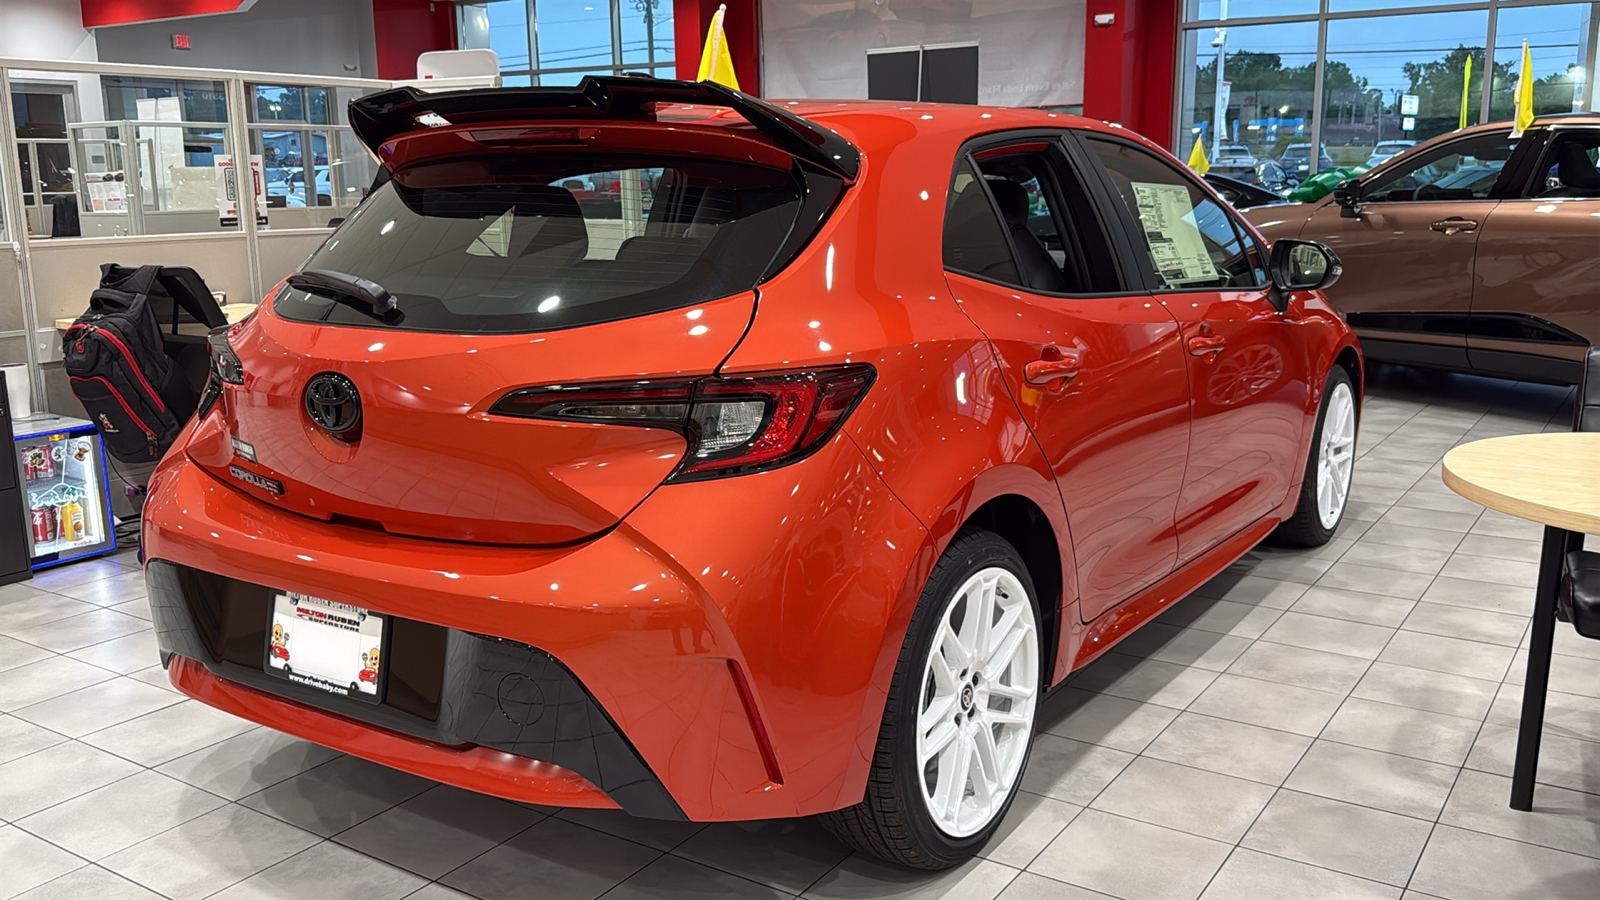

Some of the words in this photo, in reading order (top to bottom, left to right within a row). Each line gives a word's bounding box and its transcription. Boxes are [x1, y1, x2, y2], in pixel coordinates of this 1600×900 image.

[229, 465, 269, 490] COROLLA
[296, 607, 327, 619] MILTON
[328, 614, 360, 627] RUBEN
[308, 617, 360, 632] SUPERSTORE
[288, 674, 349, 696] www.drivebaby.com
